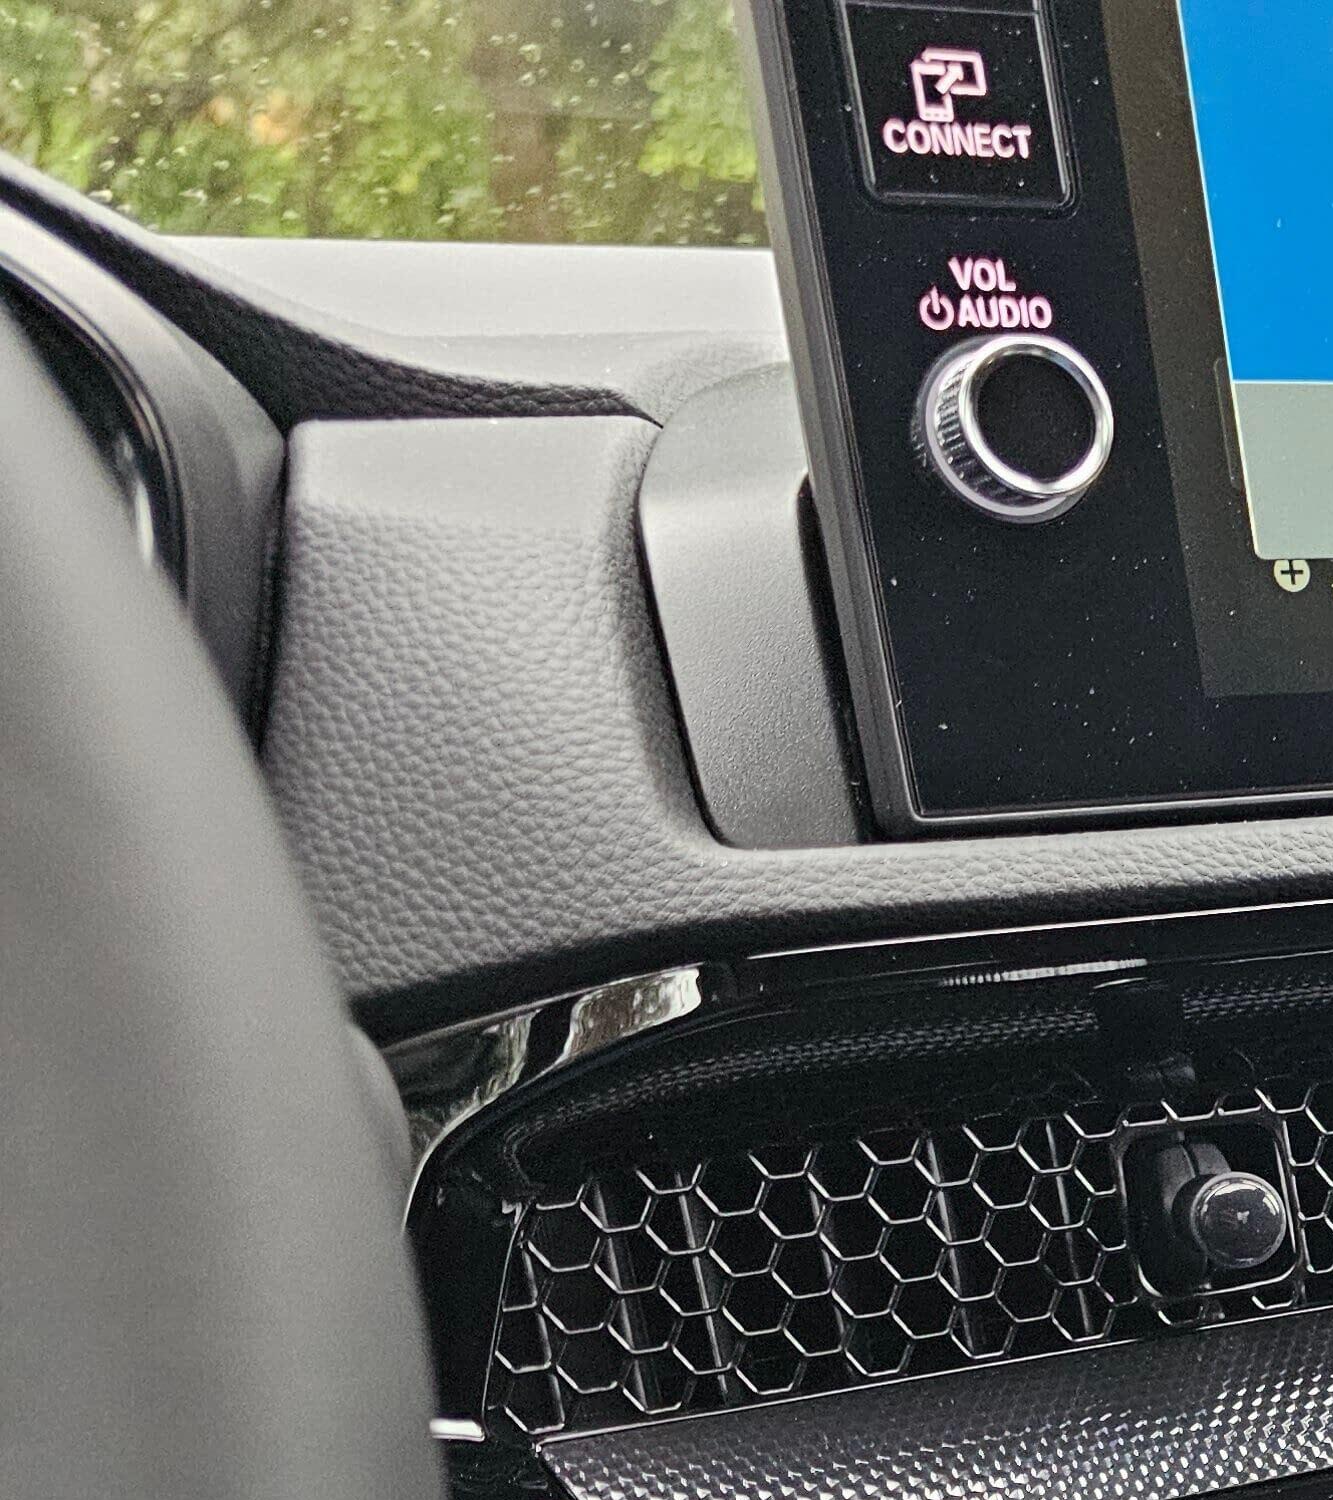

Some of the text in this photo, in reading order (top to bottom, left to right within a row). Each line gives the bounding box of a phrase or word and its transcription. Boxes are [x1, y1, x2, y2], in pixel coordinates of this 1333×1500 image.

[882, 118, 1032, 160] CONNECT
[949, 257, 1017, 292] VOL
[957, 295, 1053, 330] AUDIO
